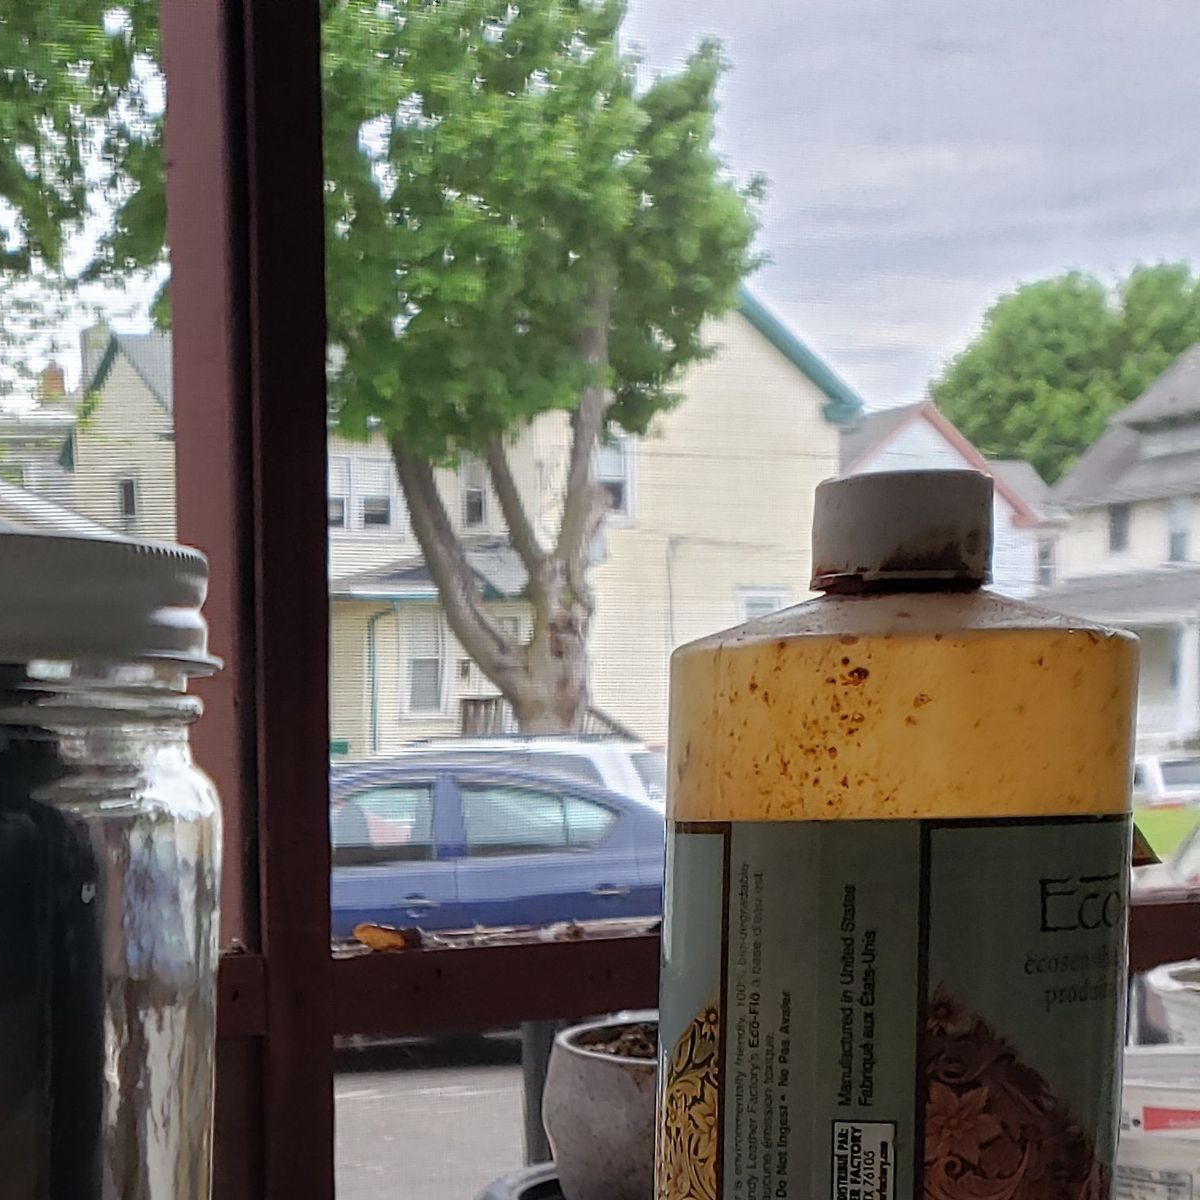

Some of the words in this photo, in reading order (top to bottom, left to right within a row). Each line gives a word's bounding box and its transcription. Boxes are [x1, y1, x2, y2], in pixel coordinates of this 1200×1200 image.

[841, 884, 856, 932] States
[840, 937, 855, 985] United
[840, 991, 853, 1002] in
[862, 1012, 873, 1038] aux
[779, 1040, 789, 1064] Pas
[838, 1008, 853, 1106] Manufactured
[747, 1053, 760, 1113] Factory's
[746, 1119, 758, 1169] Leather
[777, 1105, 790, 1147] Ingest
[776, 1152, 787, 1175] Not
[851, 1127, 862, 1185] FACTORY
[864, 1151, 875, 1187] 76105
[776, 1180, 787, 1198] Do
